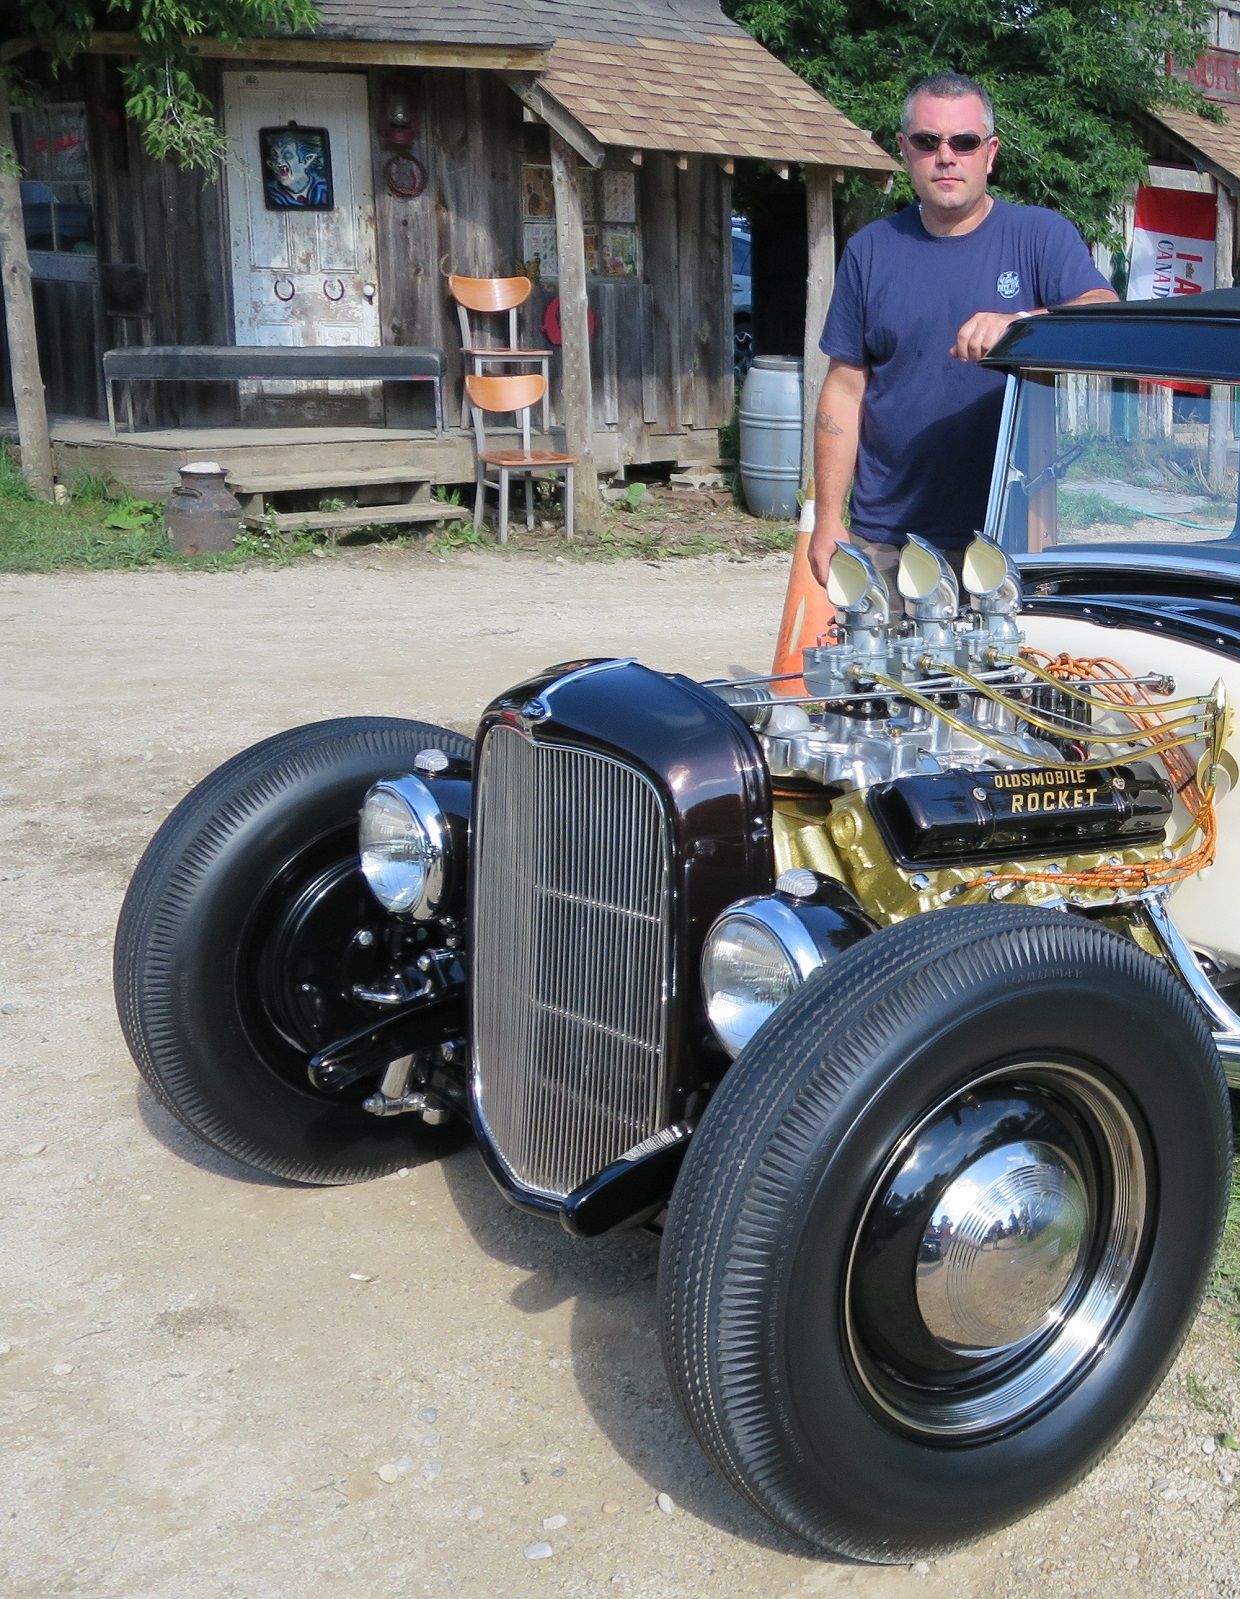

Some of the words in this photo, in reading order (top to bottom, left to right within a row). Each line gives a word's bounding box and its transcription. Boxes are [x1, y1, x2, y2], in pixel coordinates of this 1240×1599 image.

[1151, 240, 1175, 299] CANAD
[994, 769, 1087, 788] OLDSMOBILE
[1011, 788, 1098, 813] ROCKET
